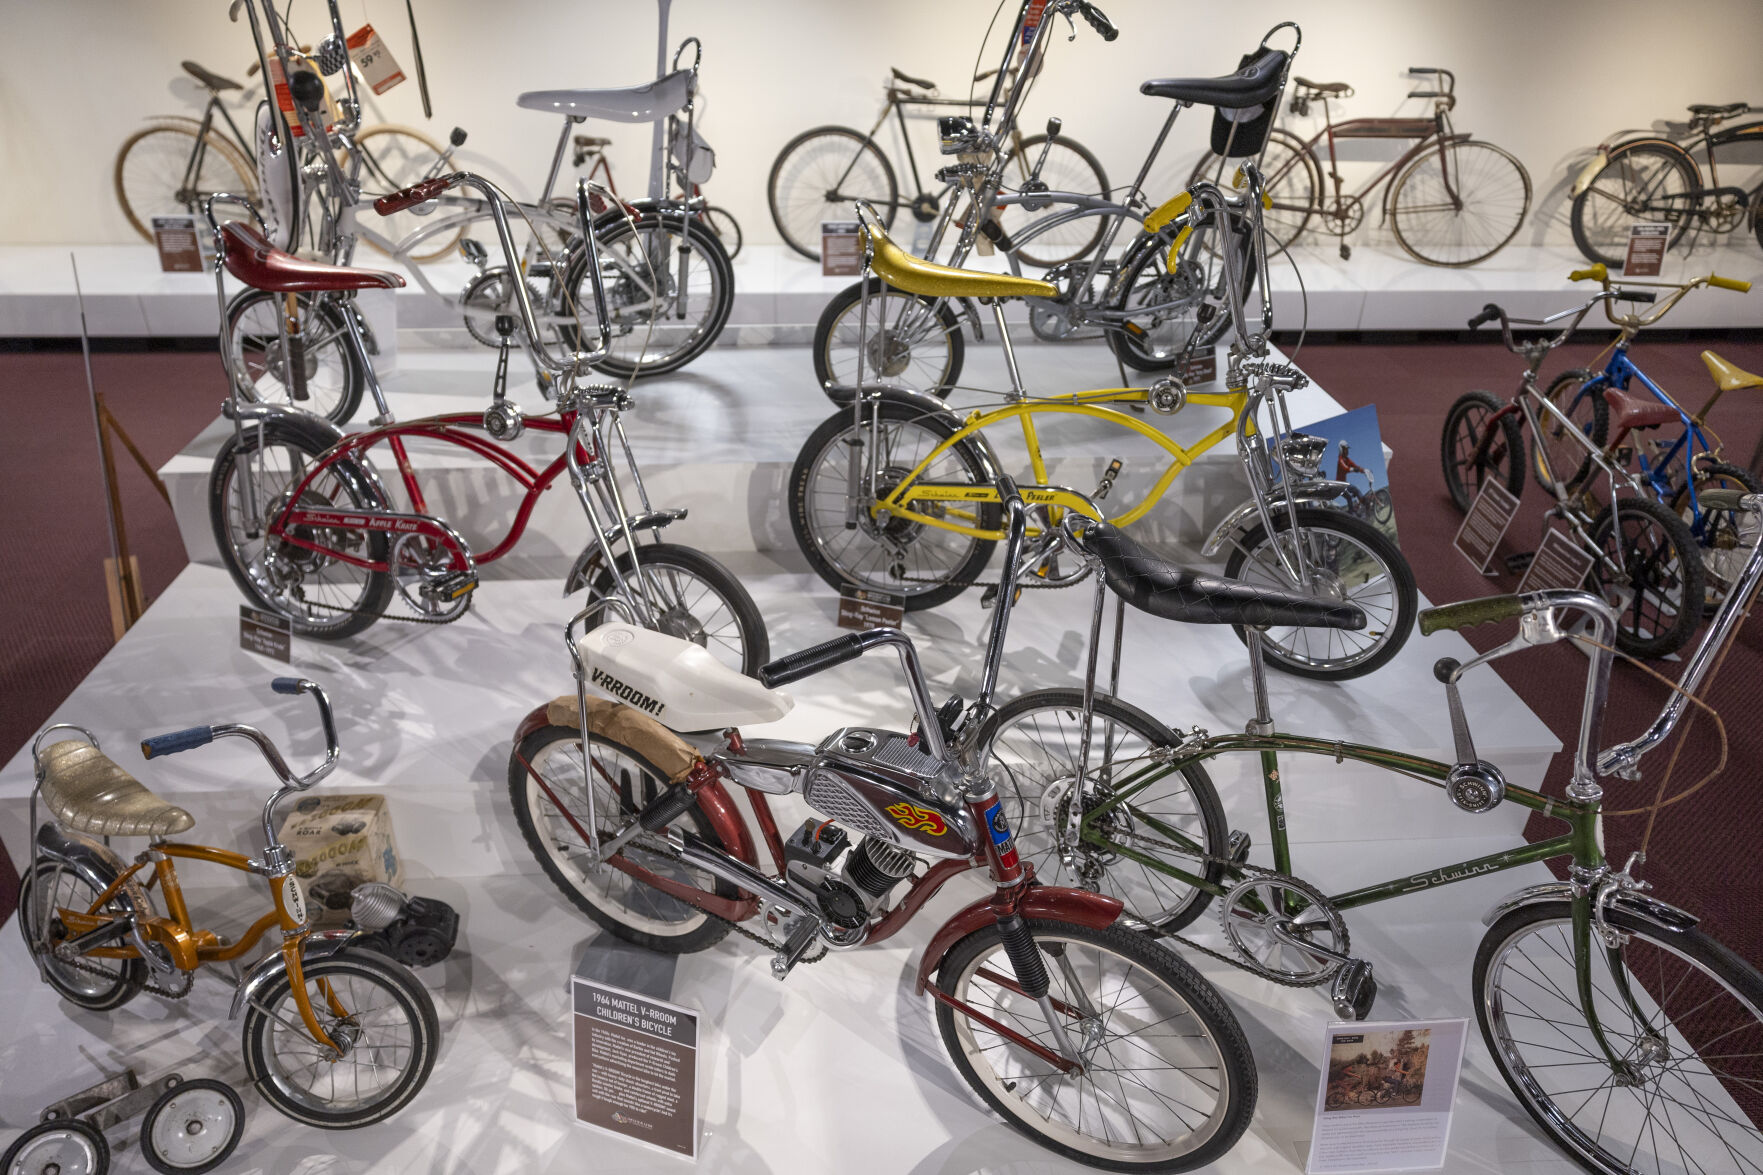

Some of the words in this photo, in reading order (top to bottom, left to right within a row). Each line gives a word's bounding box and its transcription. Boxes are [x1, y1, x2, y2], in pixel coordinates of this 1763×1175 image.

[1402, 863, 1500, 892] Schwinn
[592, 992, 610, 1006] 1964
[611, 998, 639, 1014] MATTEL
[640, 1006, 677, 1026] V-RROOM
[596, 1006, 640, 1027] CHILDREN'S
[641, 1019, 672, 1037] BICYCLE
